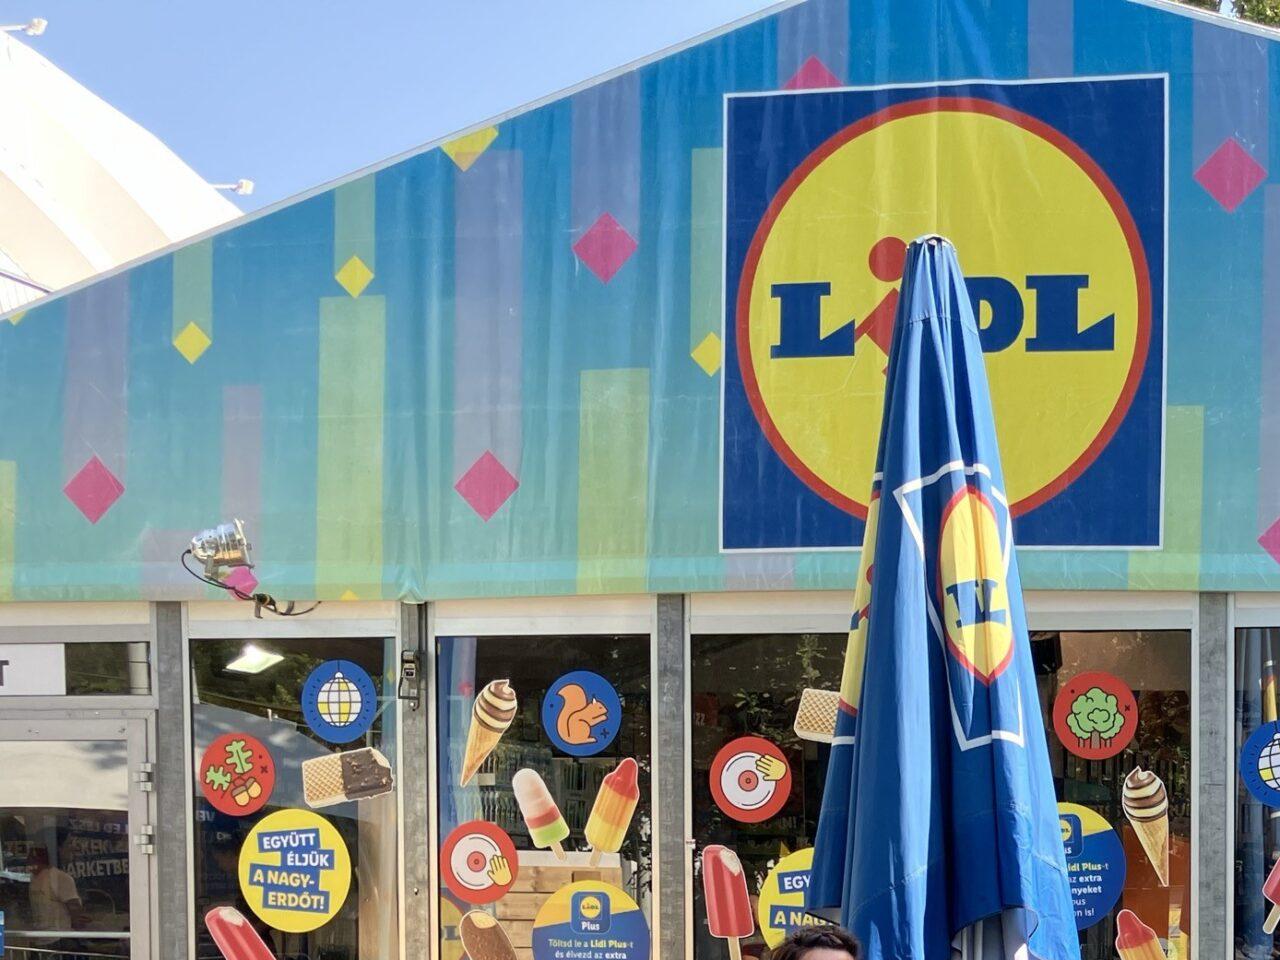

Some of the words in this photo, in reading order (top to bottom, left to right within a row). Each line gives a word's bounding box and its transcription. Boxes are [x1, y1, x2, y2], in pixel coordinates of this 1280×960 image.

[262, 832, 316, 850] EGYÜTT
[286, 851, 330, 867] ÉLJÜK
[1081, 862, 1109, 872] Plus-t
[253, 869, 264, 883] A
[267, 870, 315, 888] NAGY-
[783, 874, 812, 890] EGY
[1079, 875, 1102, 883] extra
[774, 910, 786, 925] A
[1084, 908, 1095, 917] is!
[581, 921, 600, 931] Plus
[548, 938, 573, 948] Töltsd
[574, 939, 582, 948] le
[590, 940, 607, 948] Lidl
[608, 940, 634, 949] Plus-t
[555, 950, 564, 959] és
[566, 950, 592, 959] élvezd
